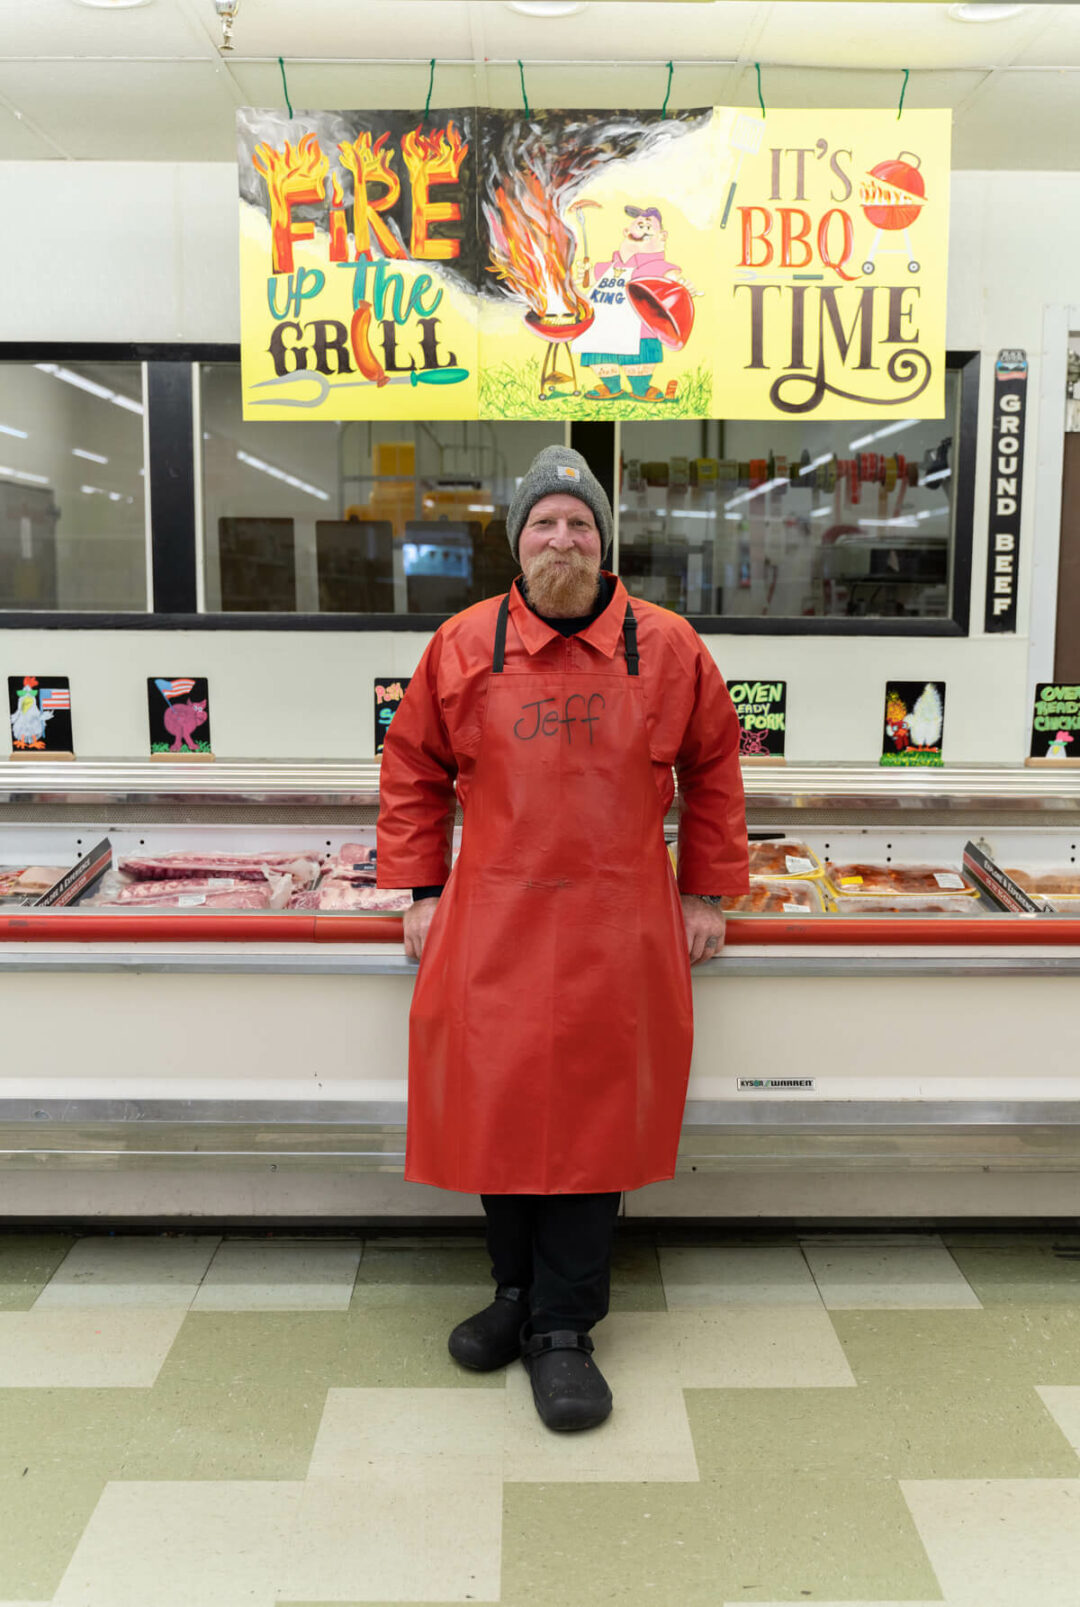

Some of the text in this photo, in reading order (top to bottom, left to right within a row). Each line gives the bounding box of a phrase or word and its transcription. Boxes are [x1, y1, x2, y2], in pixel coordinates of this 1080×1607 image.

[768, 138, 852, 202] IT'S
[735, 206, 865, 281] BBQ
[590, 290, 626, 304] KING
[600, 278, 625, 288] BBQ
[265, 301, 458, 387] GRILL
[733, 285, 931, 413] TIME
[996, 394, 1021, 516] GROUND
[993, 533, 1015, 615] BEEF
[513, 693, 606, 744] Jeff
[730, 682, 783, 704] OVEN
[736, 703, 770, 717] EADY
[744, 713, 785, 731] PORK
